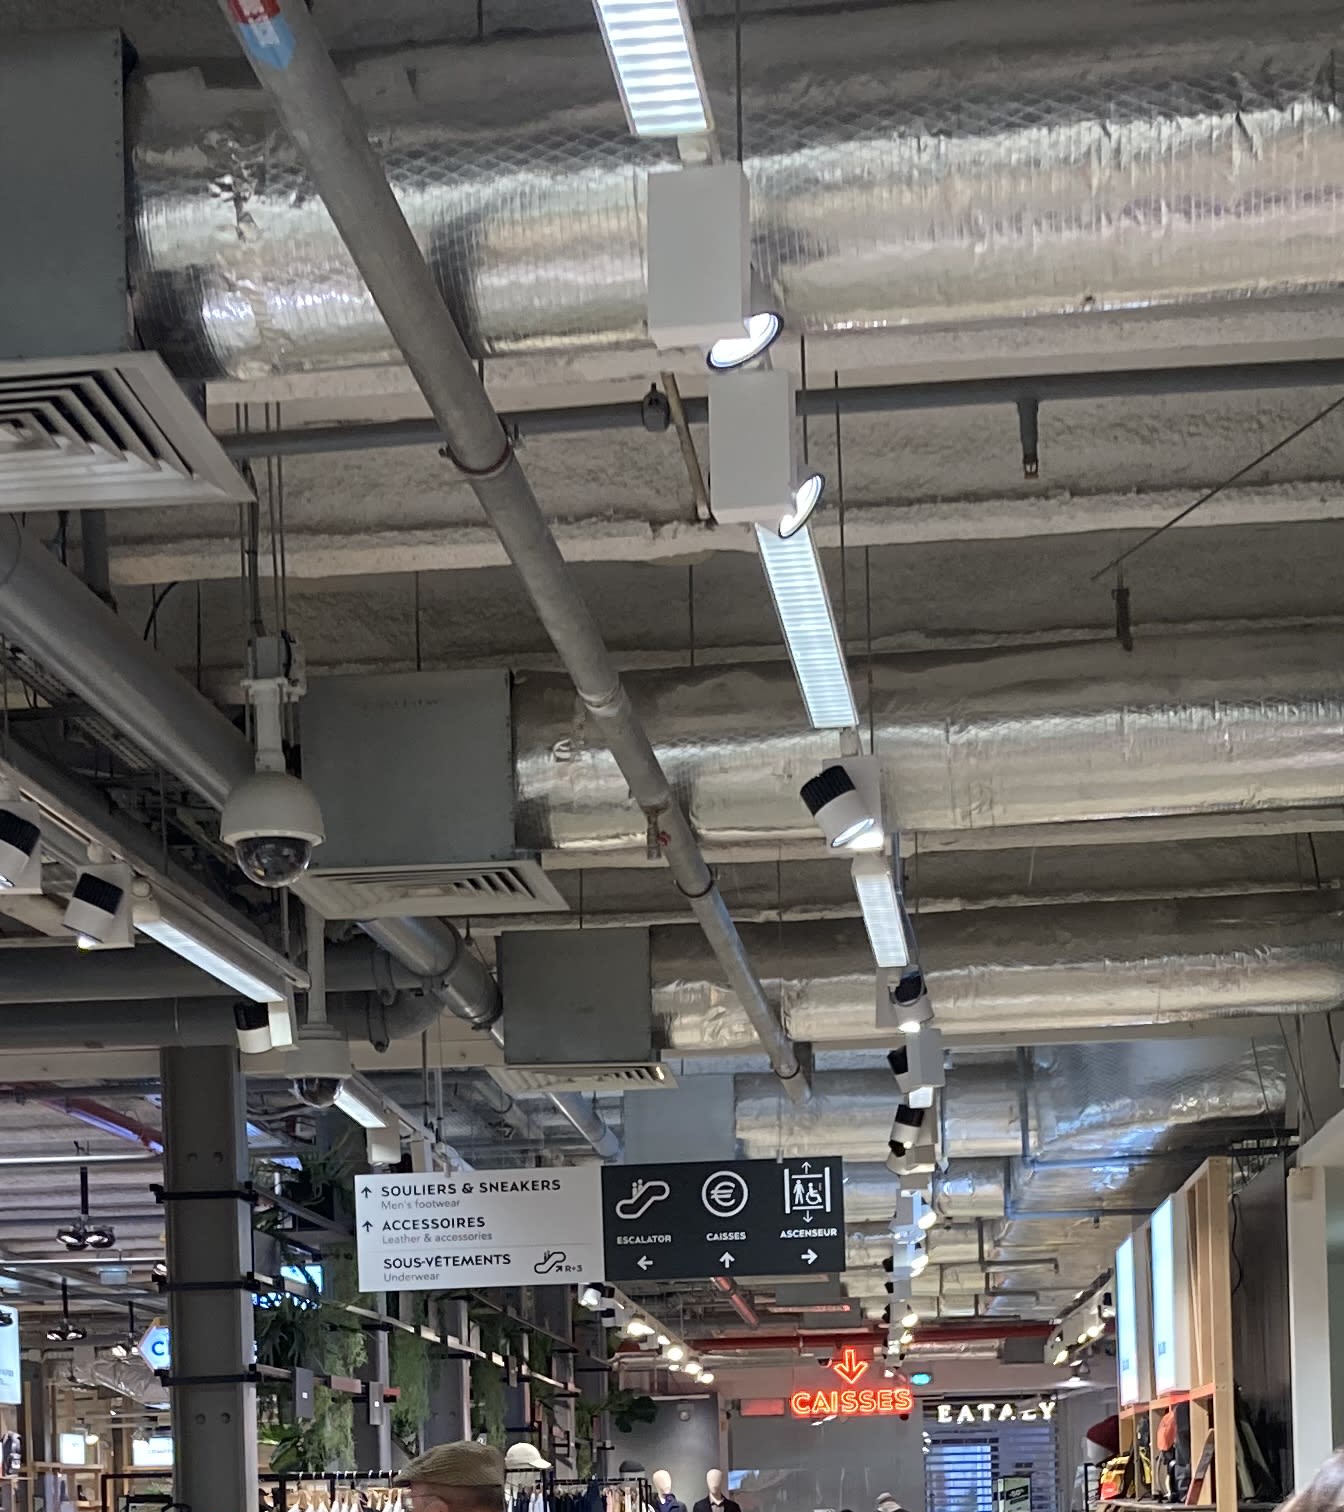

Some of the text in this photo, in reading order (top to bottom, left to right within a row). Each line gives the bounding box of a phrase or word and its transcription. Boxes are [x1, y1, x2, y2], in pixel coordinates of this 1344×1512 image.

[381, 1179, 561, 1197] SOULIERS & SNEAKERS
[381, 1198, 460, 1210] Men's footwear
[382, 1216, 486, 1231] ACCESSOIRES
[382, 1231, 493, 1245] Leather & accessories
[616, 1234, 672, 1245] ESCALATOR
[706, 1231, 747, 1241] CAISSES
[779, 1228, 838, 1239] ASCENSEUR
[383, 1253, 511, 1269] SOUS-VÊTEMENTS
[383, 1271, 440, 1283] Underwear
[790, 1388, 913, 1416] CAISSES
